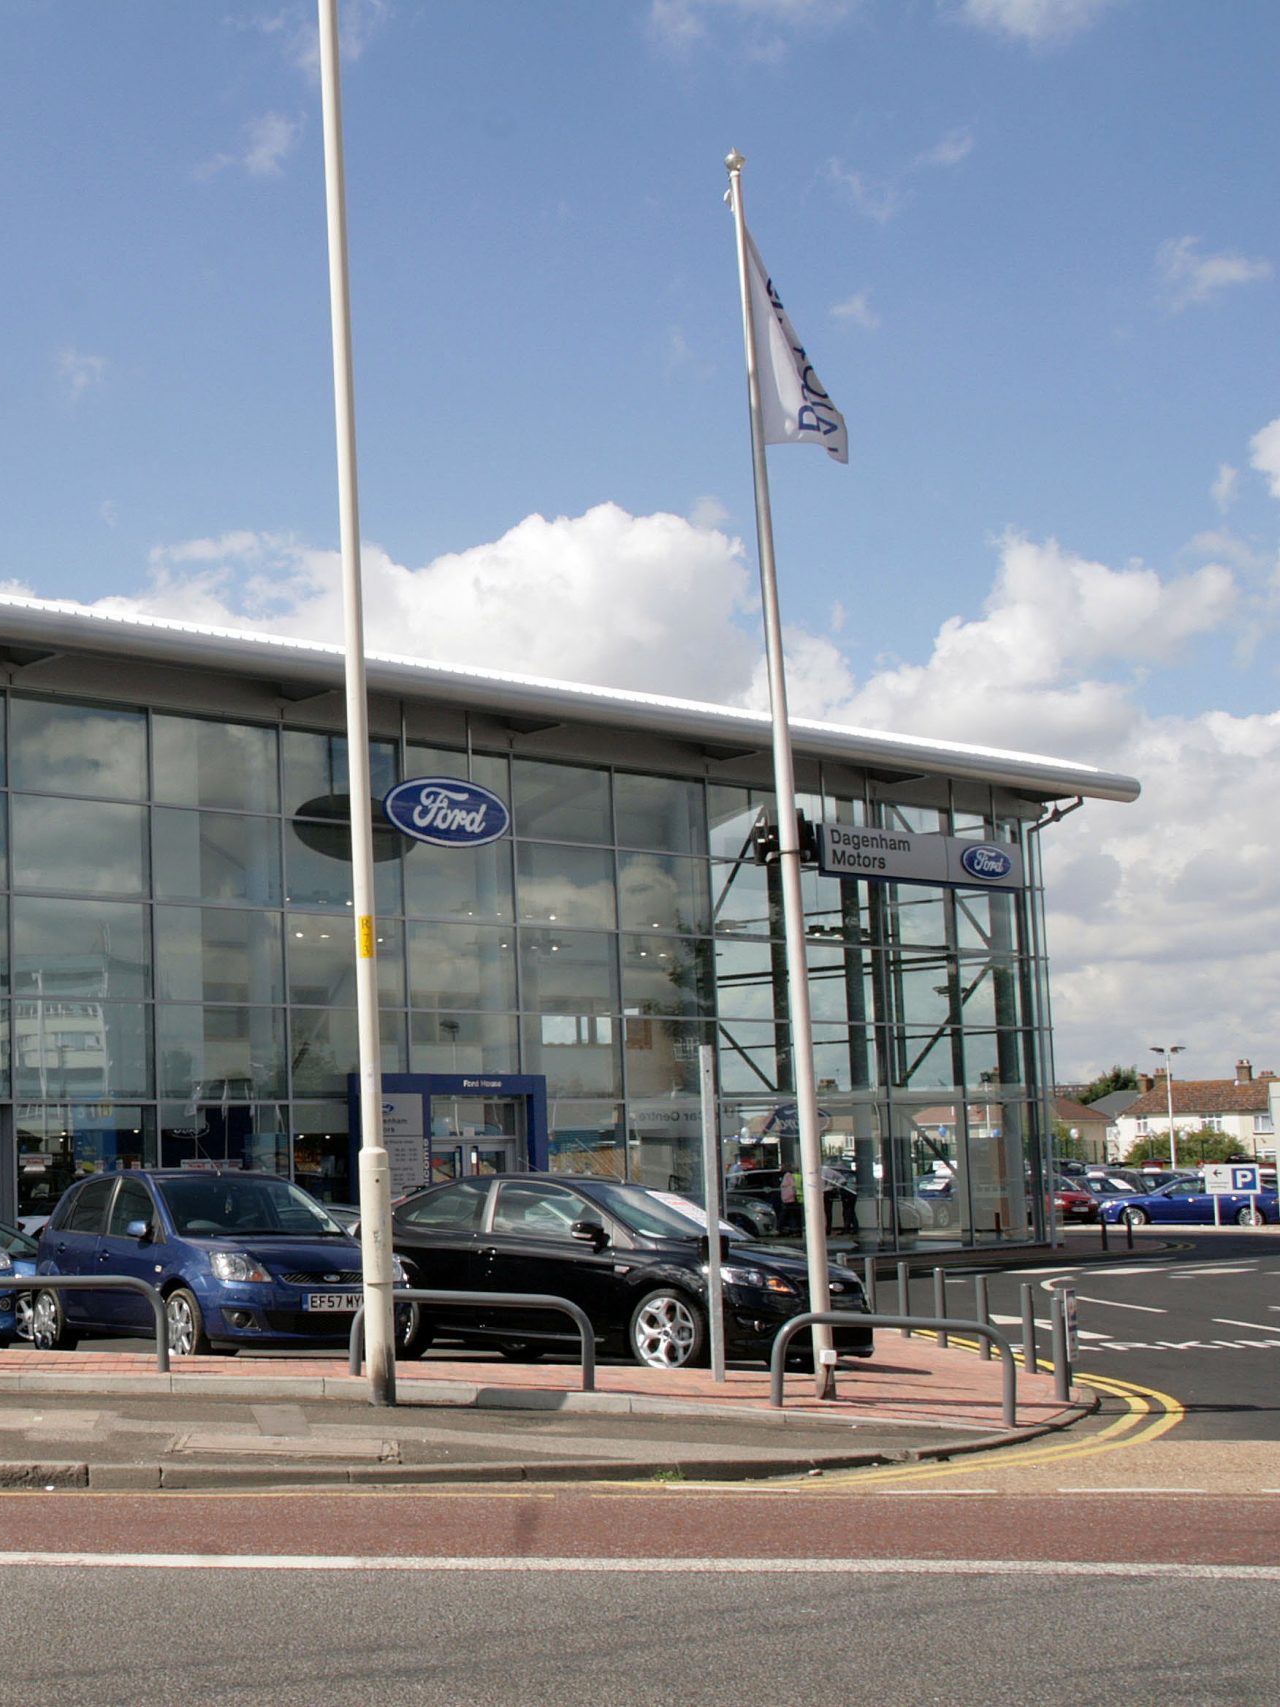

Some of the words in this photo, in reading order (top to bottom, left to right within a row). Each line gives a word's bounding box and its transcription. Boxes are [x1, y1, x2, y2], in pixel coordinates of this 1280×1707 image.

[413, 786, 487, 833] Ford
[830, 829, 911, 852] Dagenham
[832, 848, 886, 870] Motors
[973, 850, 1004, 873] Ford
[1235, 1170, 1253, 1188] P
[310, 1295, 343, 1309] EF57
[346, 1295, 365, 1309] MY
